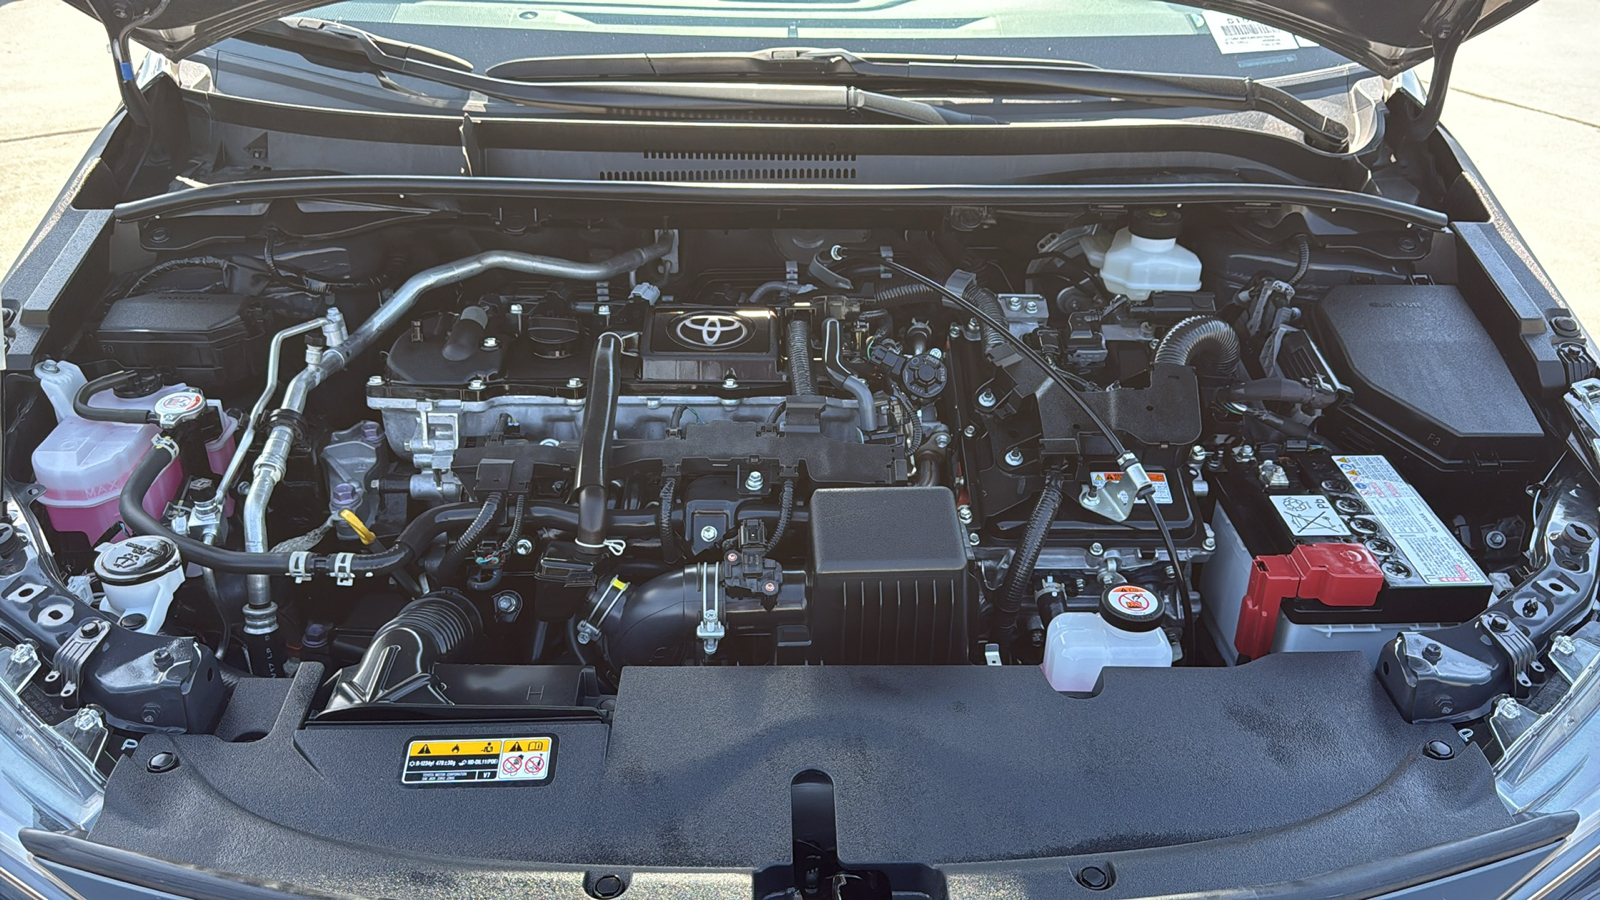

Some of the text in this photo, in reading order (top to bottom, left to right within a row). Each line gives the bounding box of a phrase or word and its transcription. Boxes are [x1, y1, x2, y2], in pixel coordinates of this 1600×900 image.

[85, 479, 119, 498] MAX
[1315, 499, 1330, 509] Pb
[526, 685, 545, 701] H
